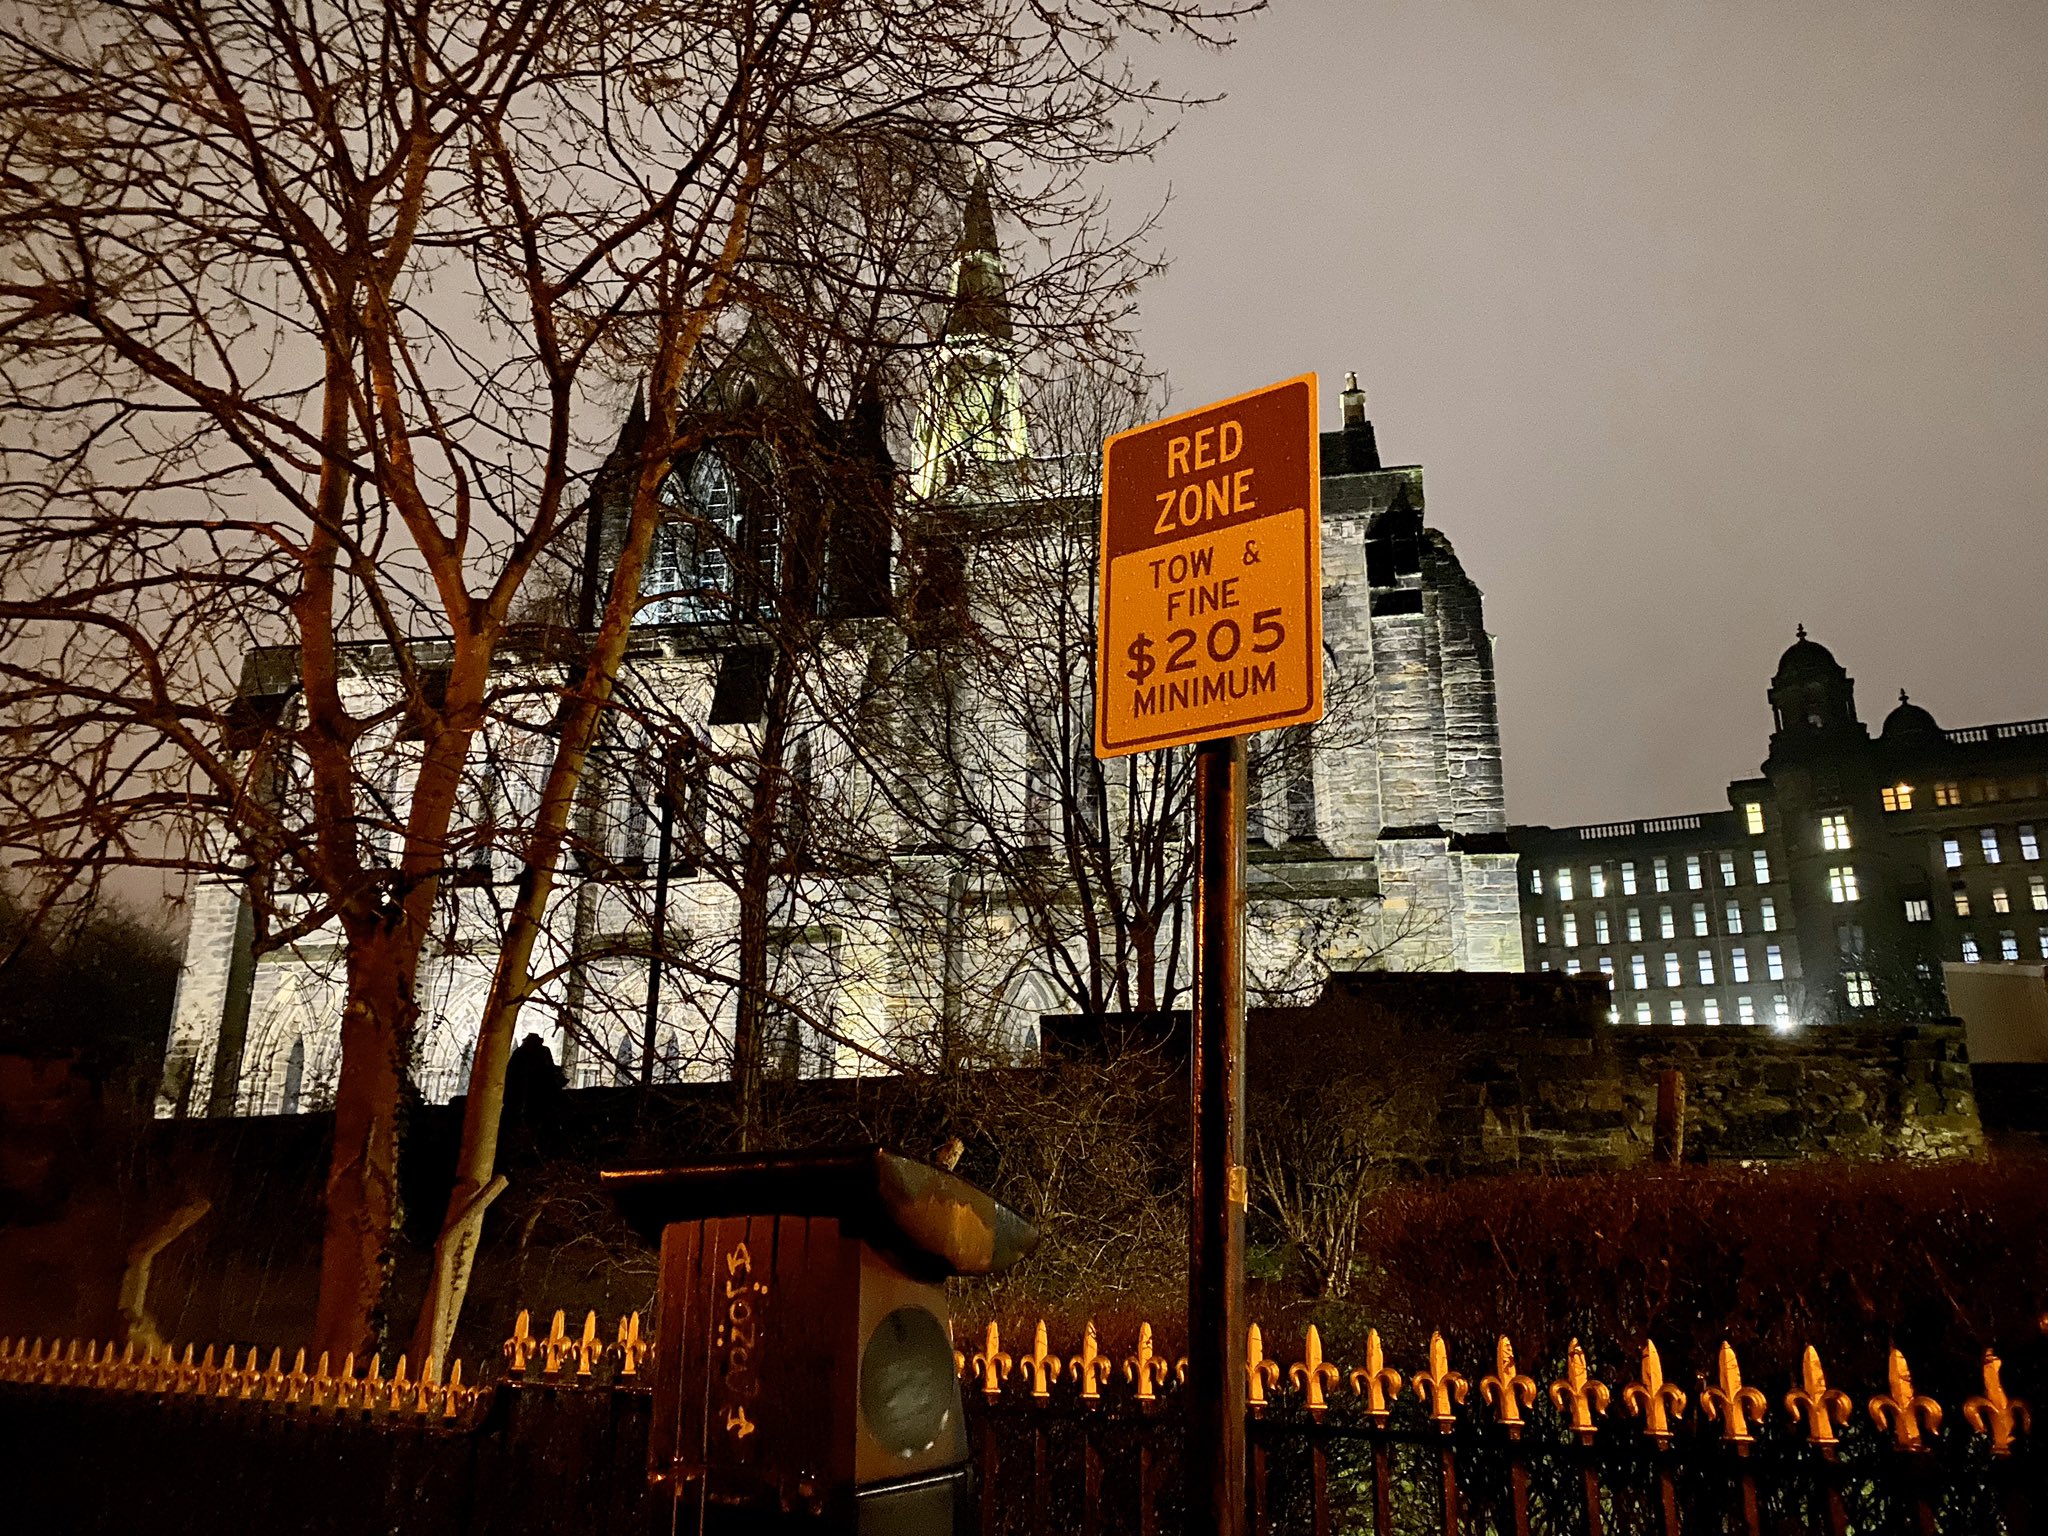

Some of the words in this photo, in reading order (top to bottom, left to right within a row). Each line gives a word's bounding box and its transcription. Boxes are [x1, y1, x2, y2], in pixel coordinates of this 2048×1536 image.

[1167, 420, 1244, 479] RED
[1153, 468, 1256, 535] ZONE
[1149, 546, 1215, 589] TOW
[1242, 539, 1261, 567] &
[1166, 576, 1240, 622] FINE
[1126, 607, 1286, 686] $205
[1132, 661, 1277, 719] MINIMUM
